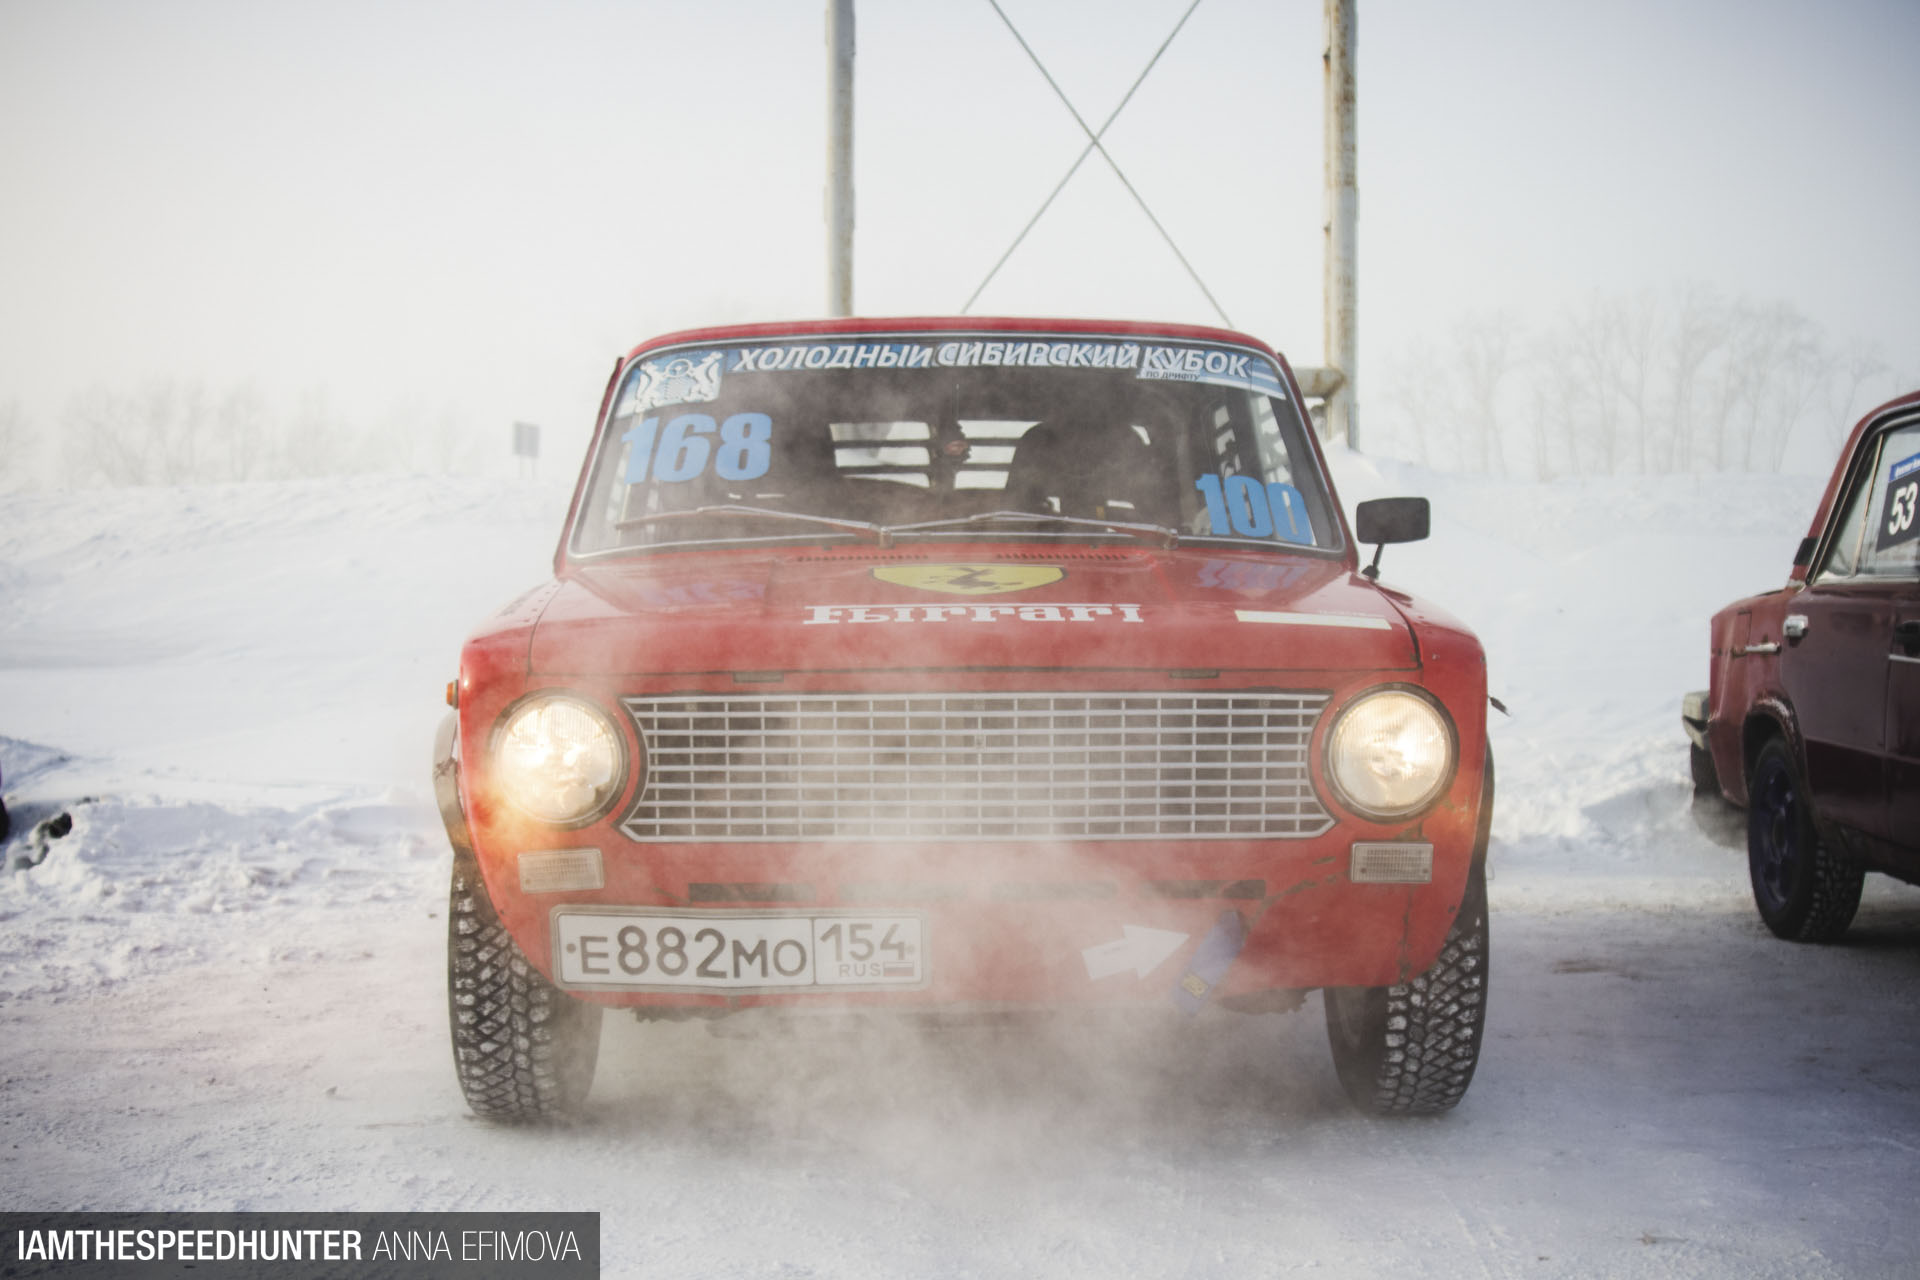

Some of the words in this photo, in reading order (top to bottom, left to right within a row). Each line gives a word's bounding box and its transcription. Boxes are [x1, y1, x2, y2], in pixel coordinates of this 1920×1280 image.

[1142, 345, 1251, 379] КУБОК
[621, 412, 773, 485] 168
[1196, 473, 1315, 546] 100
[1888, 481, 1918, 536] 53
[819, 923, 905, 961] 154
[839, 962, 881, 977] RUS
